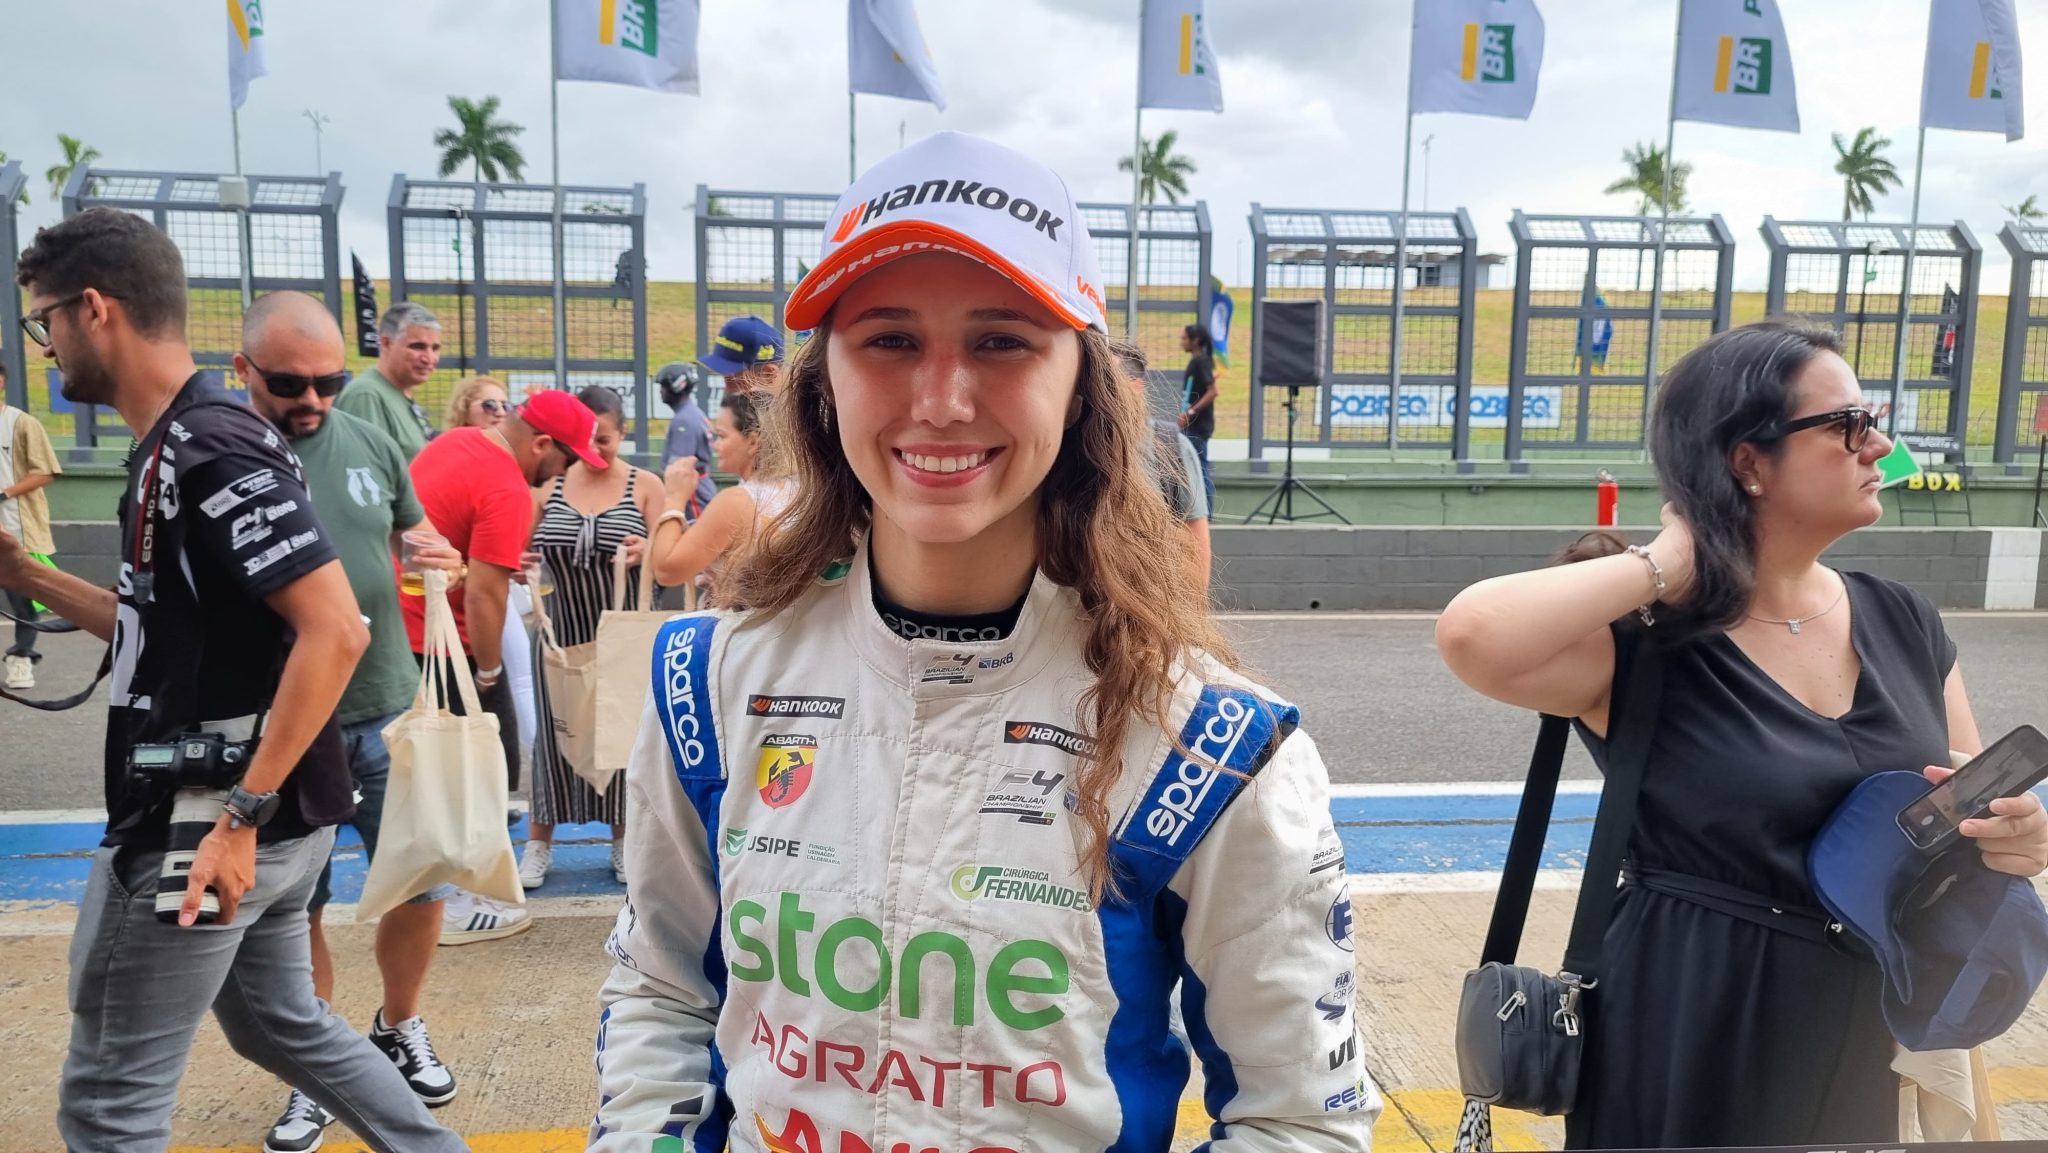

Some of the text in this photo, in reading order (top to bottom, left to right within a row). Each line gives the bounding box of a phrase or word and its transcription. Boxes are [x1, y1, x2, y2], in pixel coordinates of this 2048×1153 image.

[621, 2, 646, 50] BR
[1484, 29, 1506, 79] BR
[1736, 42, 1761, 91] BR
[142, 523, 154, 563] EOS
[882, 613, 1000, 642] sparco
[990, 652, 1014, 669] BRB
[664, 627, 704, 768] sparco
[766, 736, 816, 746] ABARTH
[993, 769, 1065, 796] F4
[1147, 697, 1250, 840] sparco
[983, 802, 1043, 810] CHAMPIONSHIP
[986, 794, 1047, 806] BRAZILIAN
[1003, 867, 1049, 882] CIRÚRGICA
[984, 878, 1094, 913] FERNANDES
[730, 892, 1069, 1031] stone
[751, 1010, 1067, 1109] AGRATTO
[1329, 1034, 1357, 1071] VI
